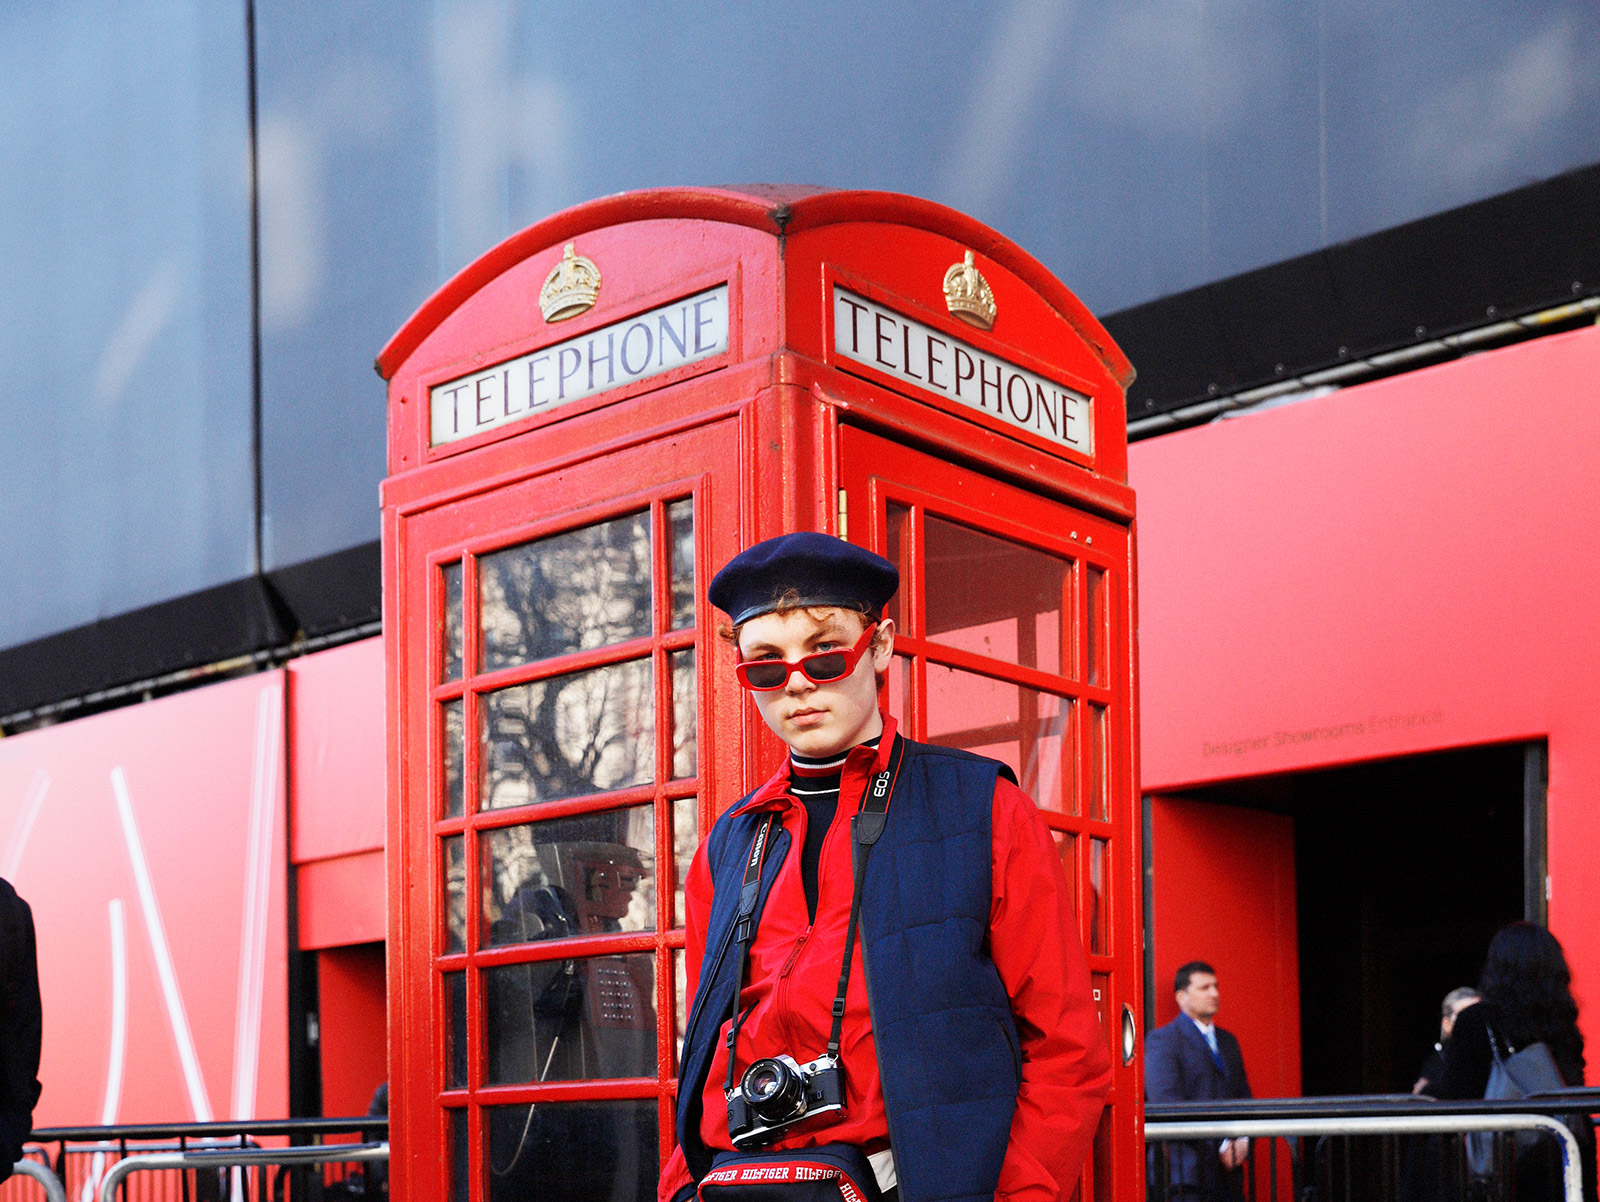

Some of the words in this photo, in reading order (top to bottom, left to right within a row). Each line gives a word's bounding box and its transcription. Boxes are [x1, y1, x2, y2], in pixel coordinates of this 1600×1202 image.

[443, 296, 719, 434] TELEPHONE
[839, 297, 1079, 444] TELEPHONE
[1202, 737, 1269, 757] Designer
[1274, 723, 1364, 746] Showrooms
[1369, 712, 1443, 733] Entrance
[873, 771, 890, 797] EOS
[751, 822, 768, 867] Canon
